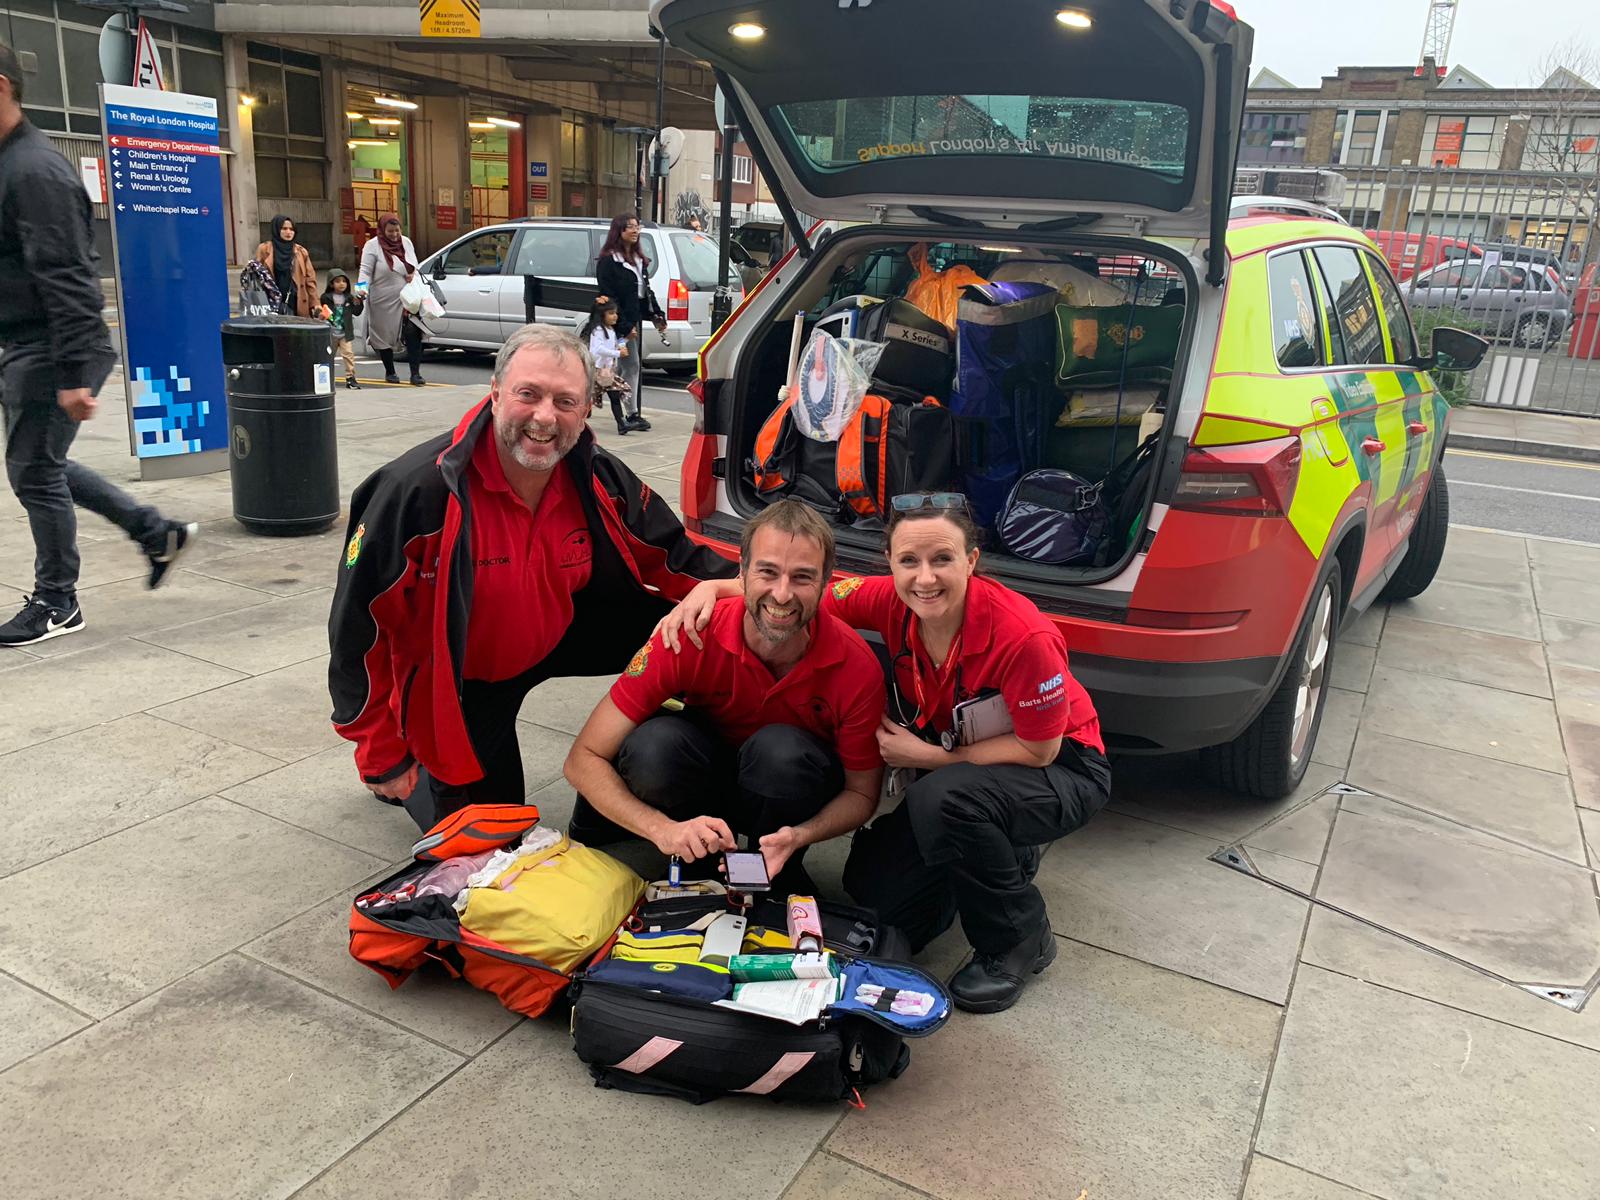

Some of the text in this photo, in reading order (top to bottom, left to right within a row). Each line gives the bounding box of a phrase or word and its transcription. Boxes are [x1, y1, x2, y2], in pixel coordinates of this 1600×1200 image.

[110, 110, 216, 131] The Royal London Hospital
[127, 138, 170, 150] Emergency
[171, 143, 209, 152] Department
[128, 150, 197, 163] Children's Hospital
[129, 161, 149, 169] Main
[151, 163, 183, 172] Entrance
[531, 165, 546, 173] OUT
[130, 172, 189, 185] Renal & Urology
[131, 182, 192, 193] Women's Centre
[133, 204, 199, 215] Whitechapel Road
[1283, 319, 1300, 337] NHS
[902, 329, 937, 346] X Series
[478, 557, 511, 567] DOCTOR
[1040, 673, 1062, 693] NHS
[1019, 687, 1065, 707] Barts Health
